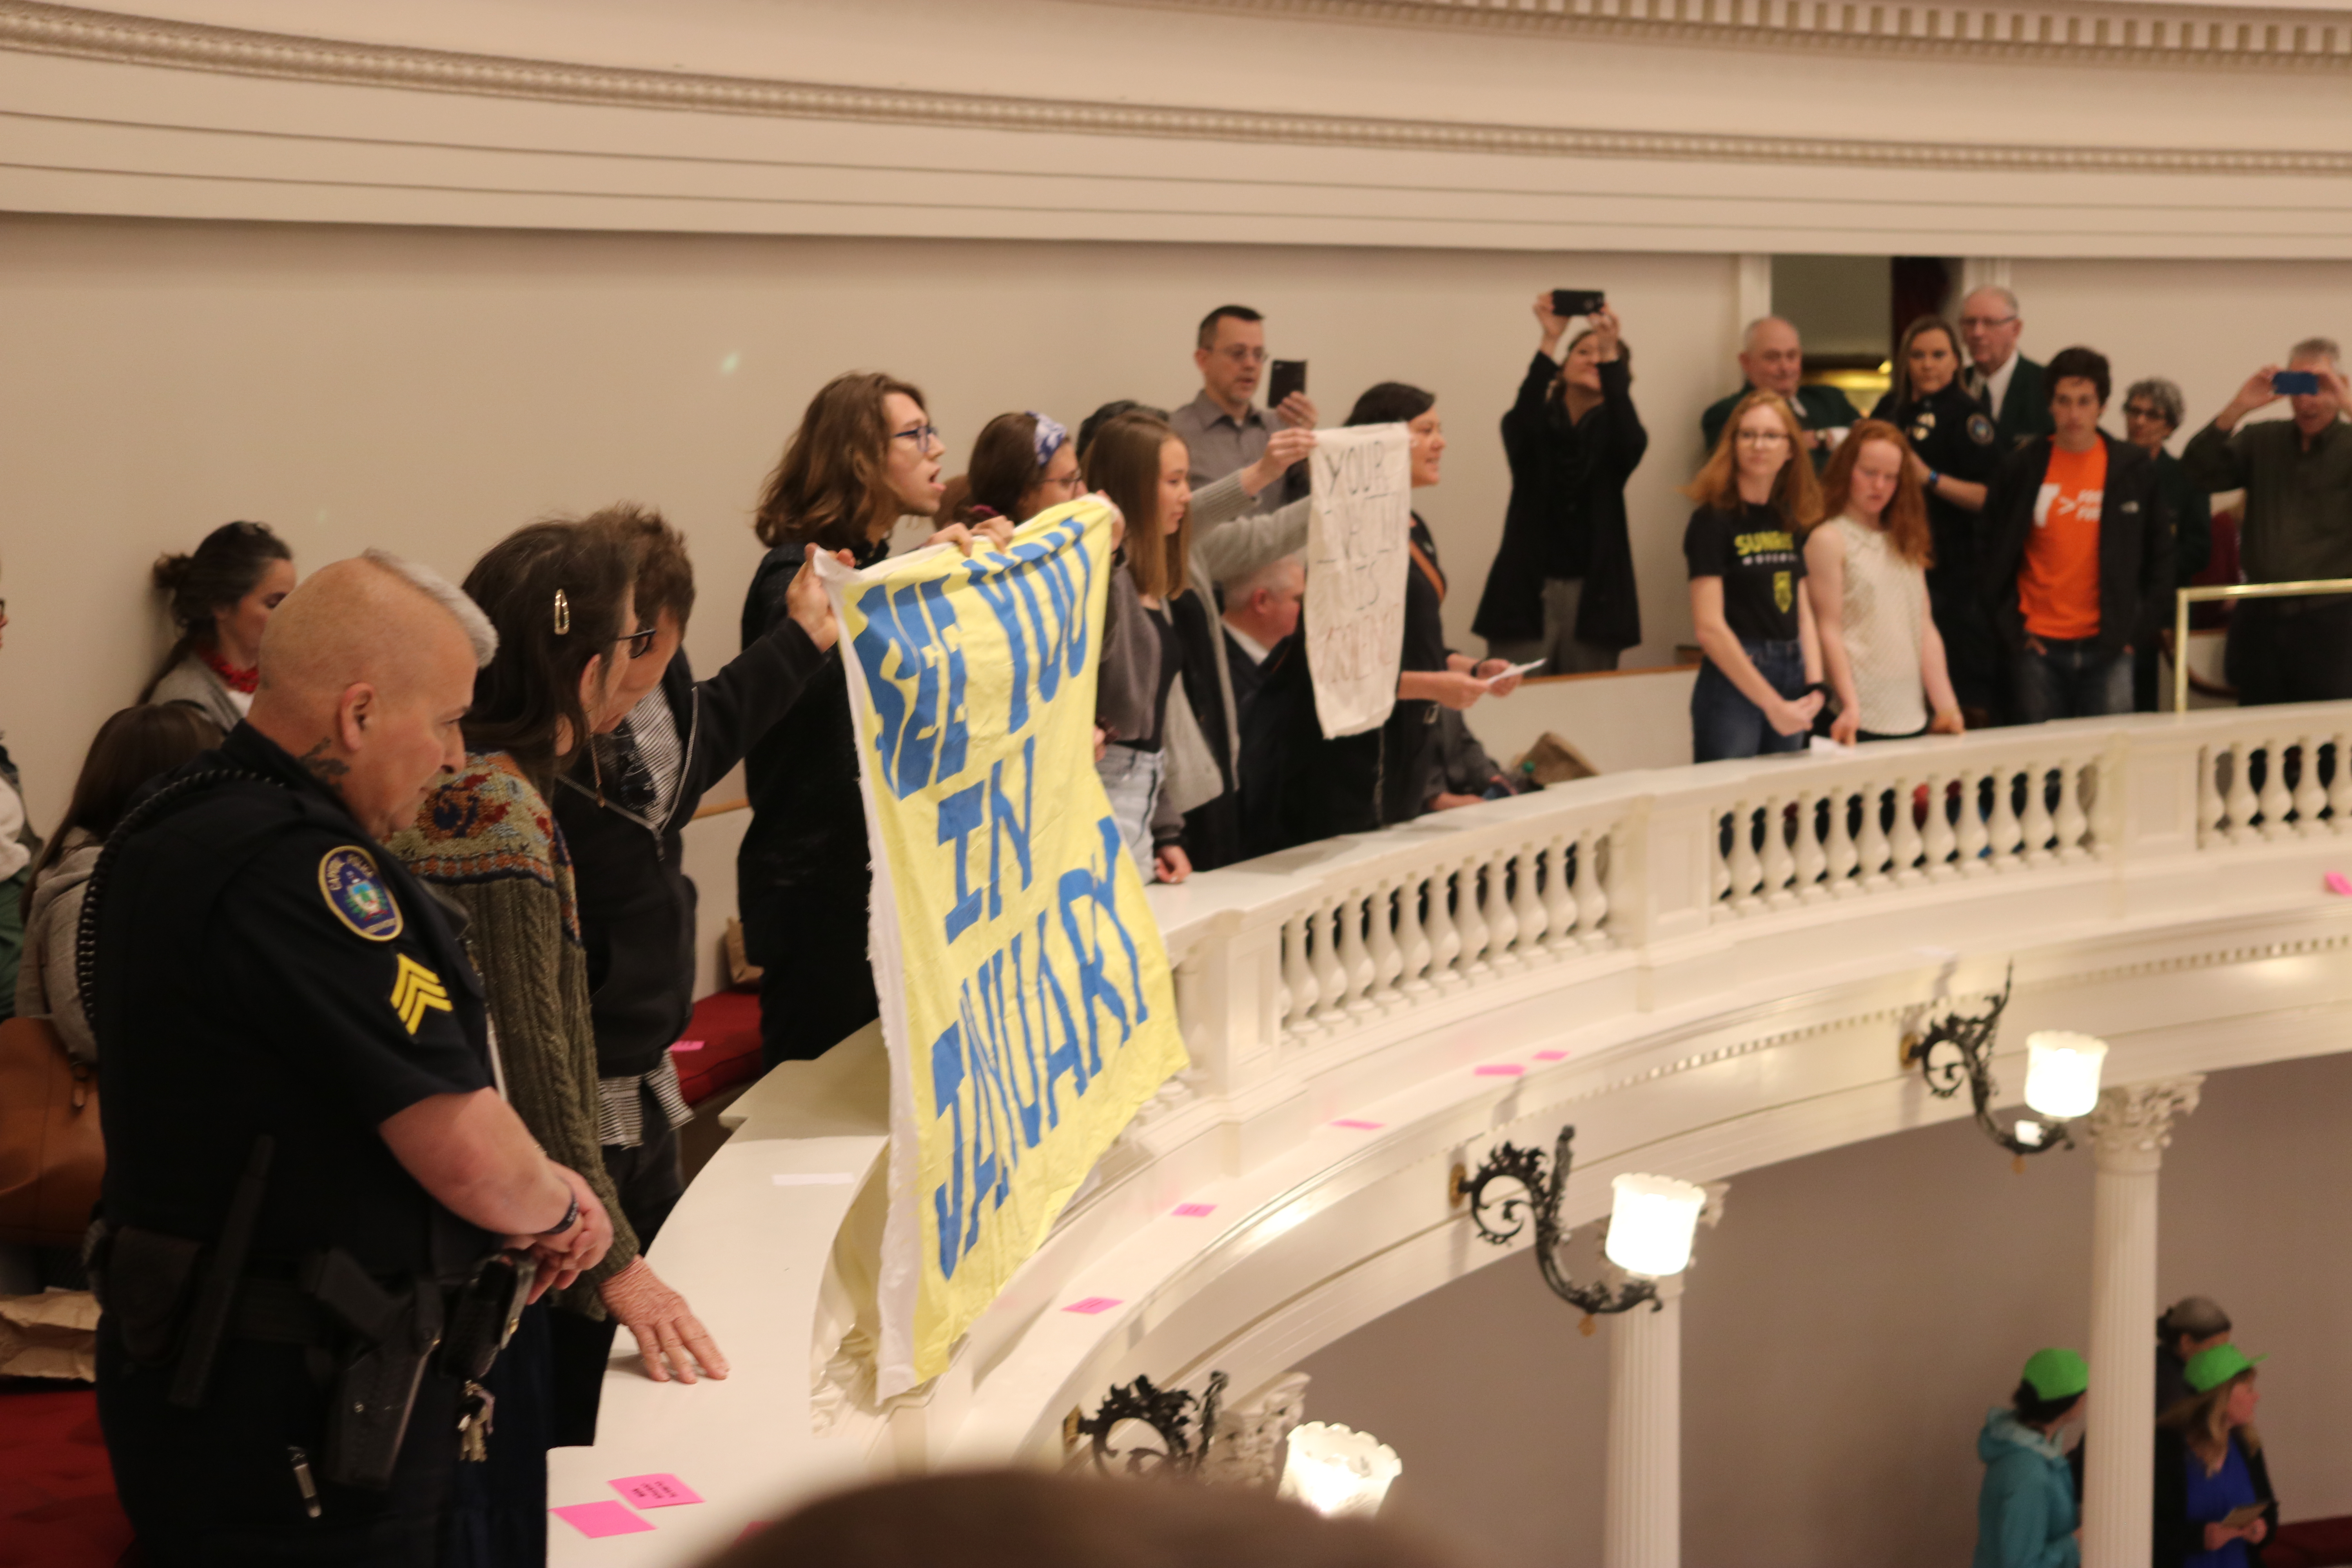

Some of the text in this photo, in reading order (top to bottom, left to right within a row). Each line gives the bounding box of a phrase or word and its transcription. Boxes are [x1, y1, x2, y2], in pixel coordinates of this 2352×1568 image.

[1324, 440, 1389, 496] YOUR
[852, 516, 1091, 801] SEE YOU
[937, 733, 1035, 946] IN
[931, 815, 1149, 1281] JANUARY
